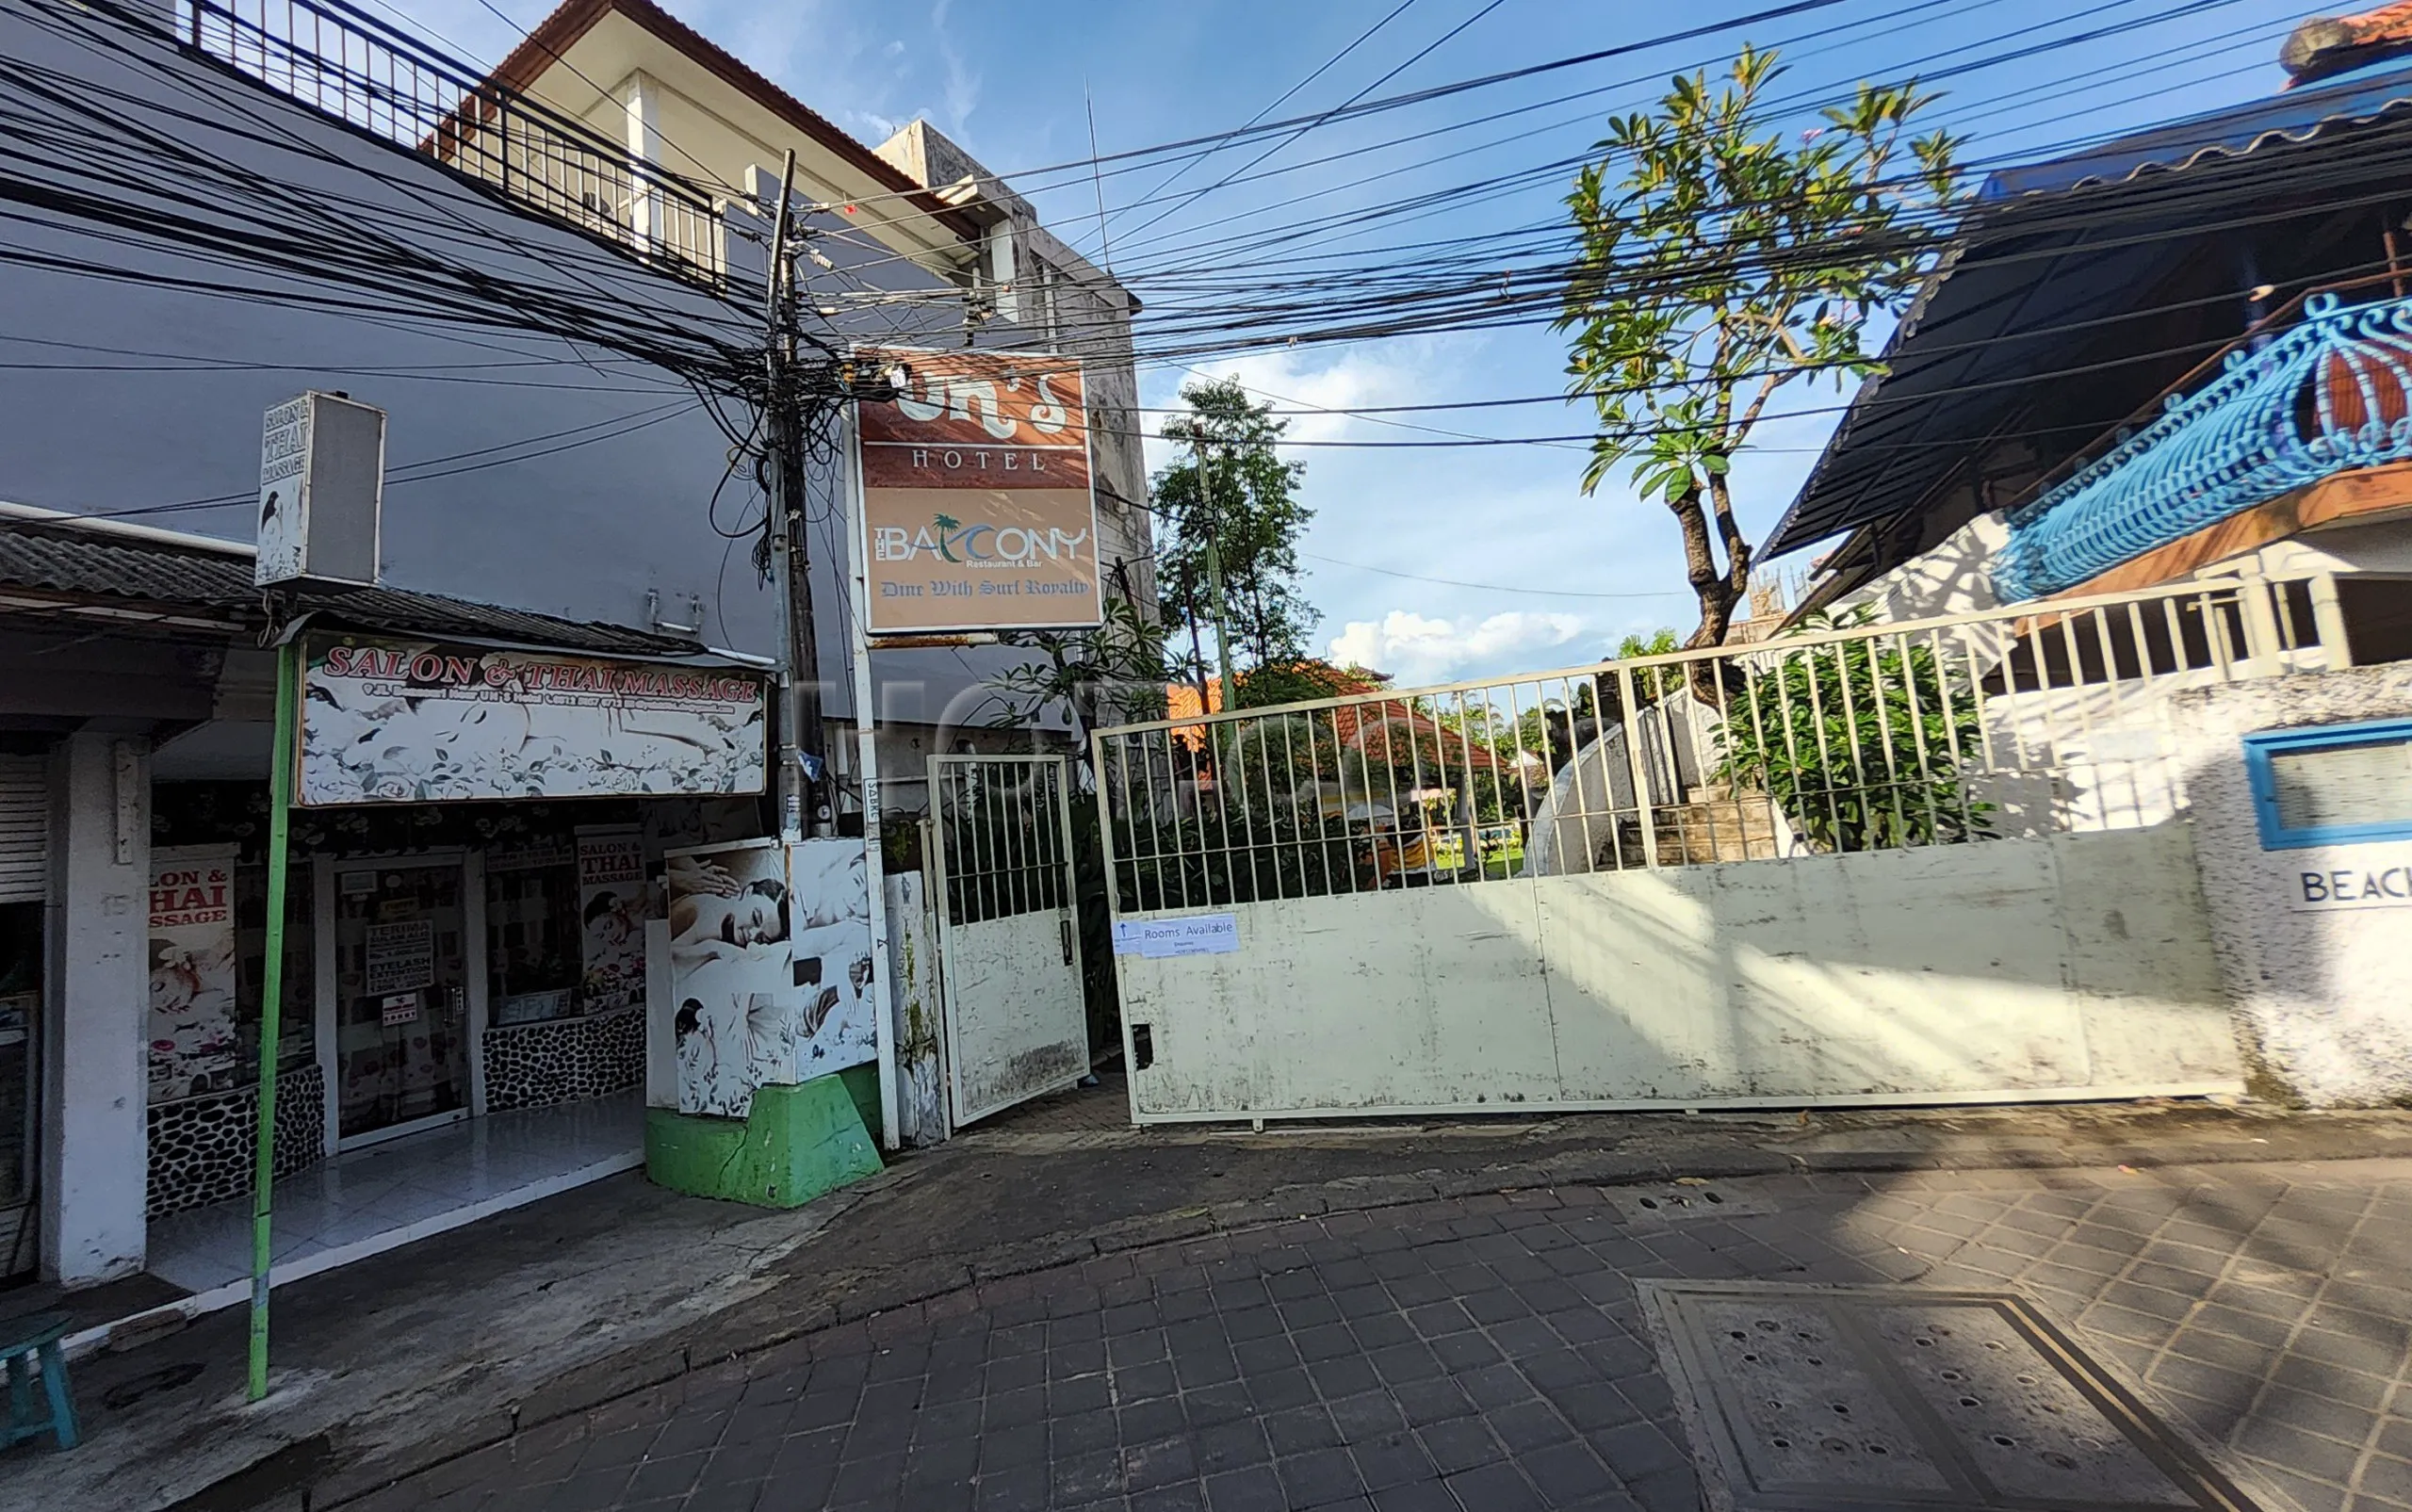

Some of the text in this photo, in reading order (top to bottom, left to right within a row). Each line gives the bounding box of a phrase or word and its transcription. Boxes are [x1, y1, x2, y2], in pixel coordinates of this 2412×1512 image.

[265, 422, 308, 463] THAI
[911, 449, 1047, 472] HOTEL
[873, 528, 887, 561] THE
[966, 559, 1043, 569] Restaurant & Bar
[880, 578, 1089, 598] Dine With Surf Royalty
[324, 646, 758, 704] SALON & THAI MASSAGE
[579, 841, 627, 855] SALON
[581, 853, 643, 875] THAI
[207, 869, 228, 883] &
[581, 870, 644, 886] MASSAGE
[149, 886, 227, 914] HAI
[149, 909, 227, 928] SSAGE
[1144, 928, 1181, 940] Rooms
[1185, 921, 1233, 936] Available
[368, 957, 432, 973] EYELASH
